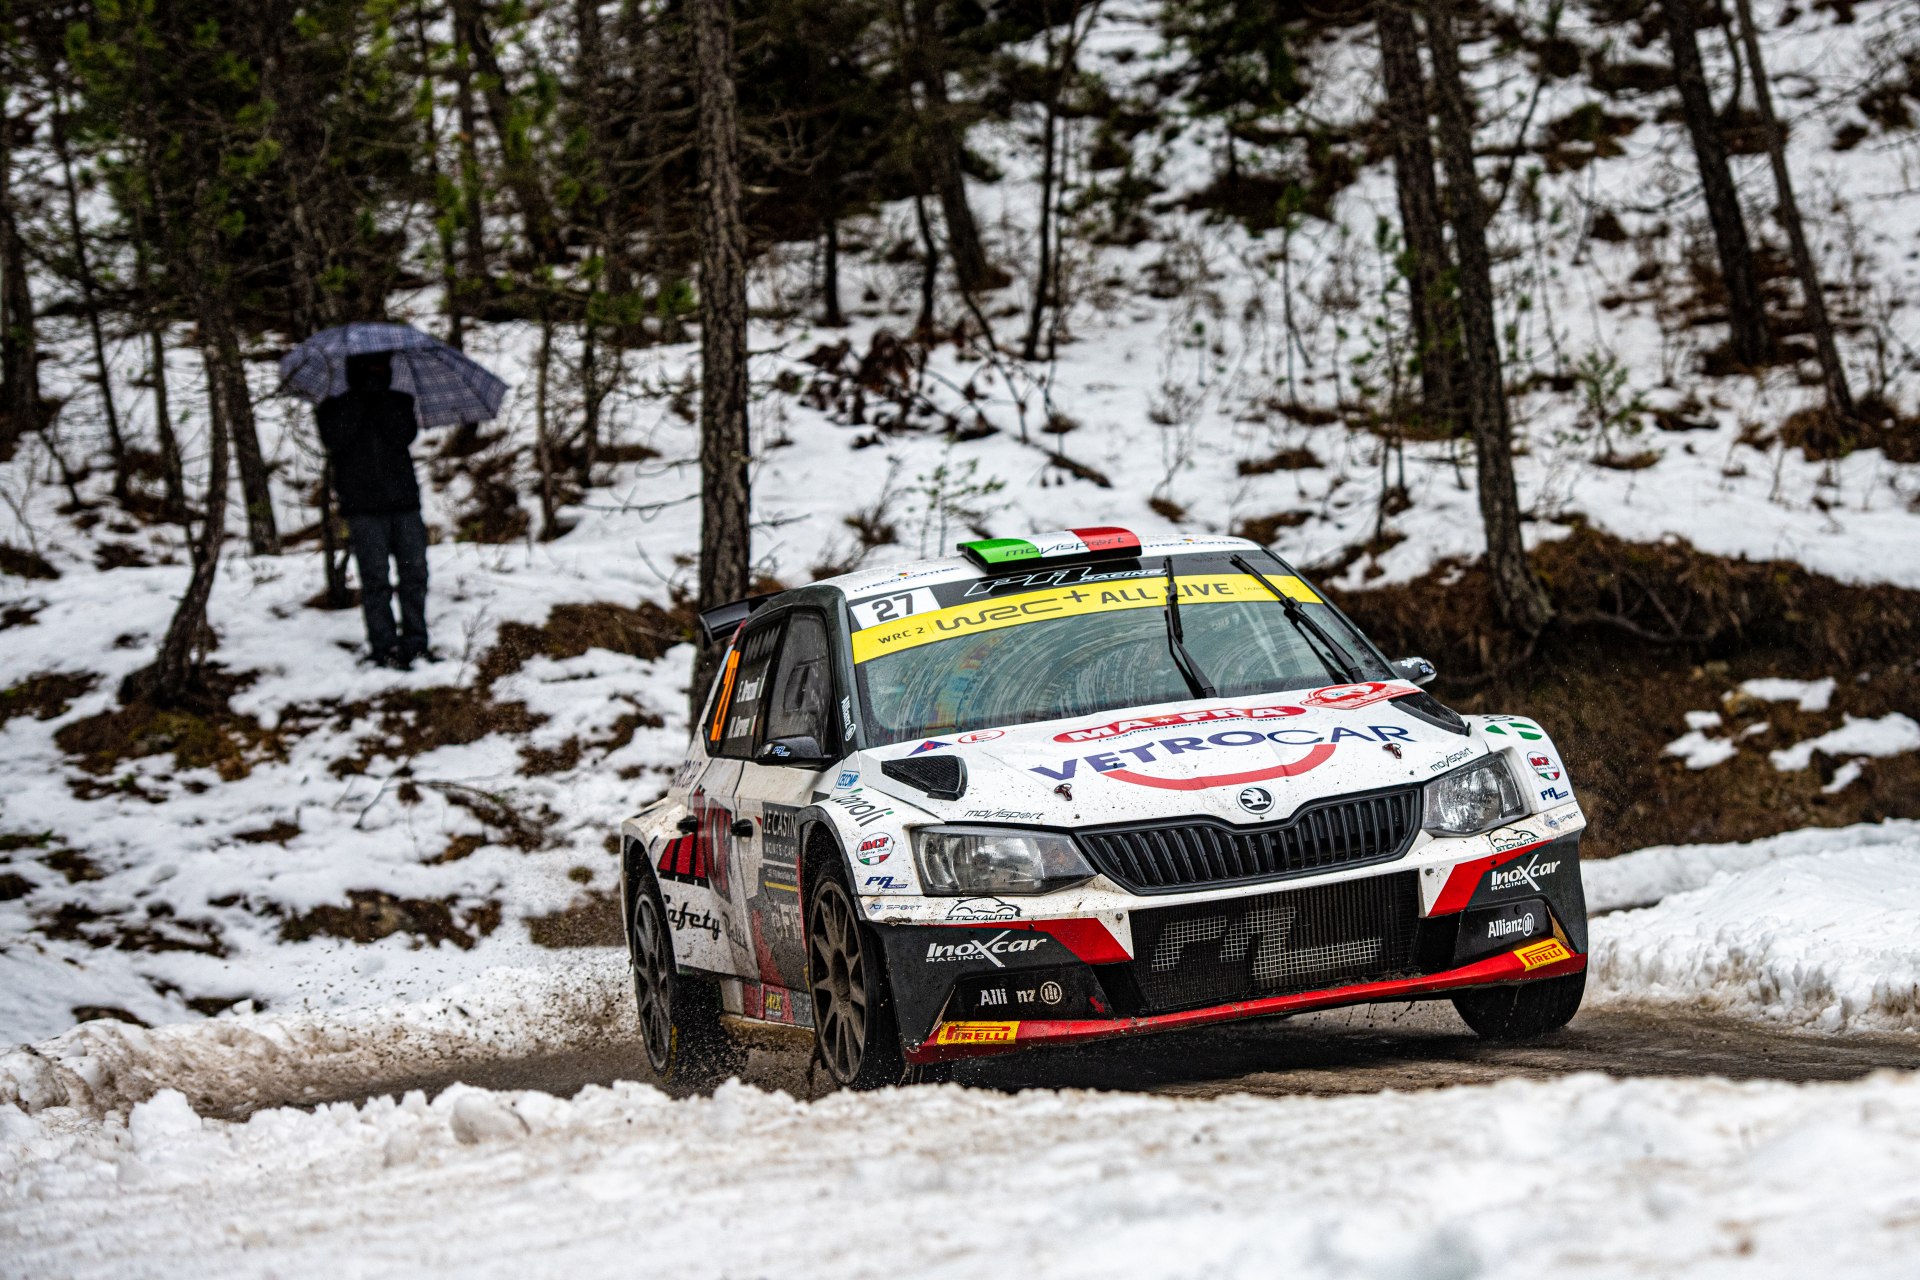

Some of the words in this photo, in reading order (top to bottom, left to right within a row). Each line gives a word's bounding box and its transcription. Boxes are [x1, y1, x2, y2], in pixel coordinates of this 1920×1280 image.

[1005, 536, 1125, 558] movisport
[1101, 588, 1158, 604] ALL
[872, 593, 914, 623] 27
[877, 629, 912, 645] WRC
[915, 627, 925, 636] 2
[1028, 725, 1418, 781] VETROCAR
[1430, 747, 1474, 772] movisport
[964, 808, 1045, 820] movisport
[772, 810, 798, 838] CASIN
[859, 837, 889, 851] MCF
[1491, 879, 1528, 892] RACING
[886, 903, 923, 911] SPORT
[664, 894, 722, 941] afety
[944, 913, 1014, 921] STICKAUTO
[1488, 917, 1523, 939] Allianz
[925, 954, 985, 963] RACING
[1522, 943, 1564, 966] PIRELLI
[980, 988, 1036, 1007] Allinz
[945, 1026, 1011, 1041] PIRELLI
